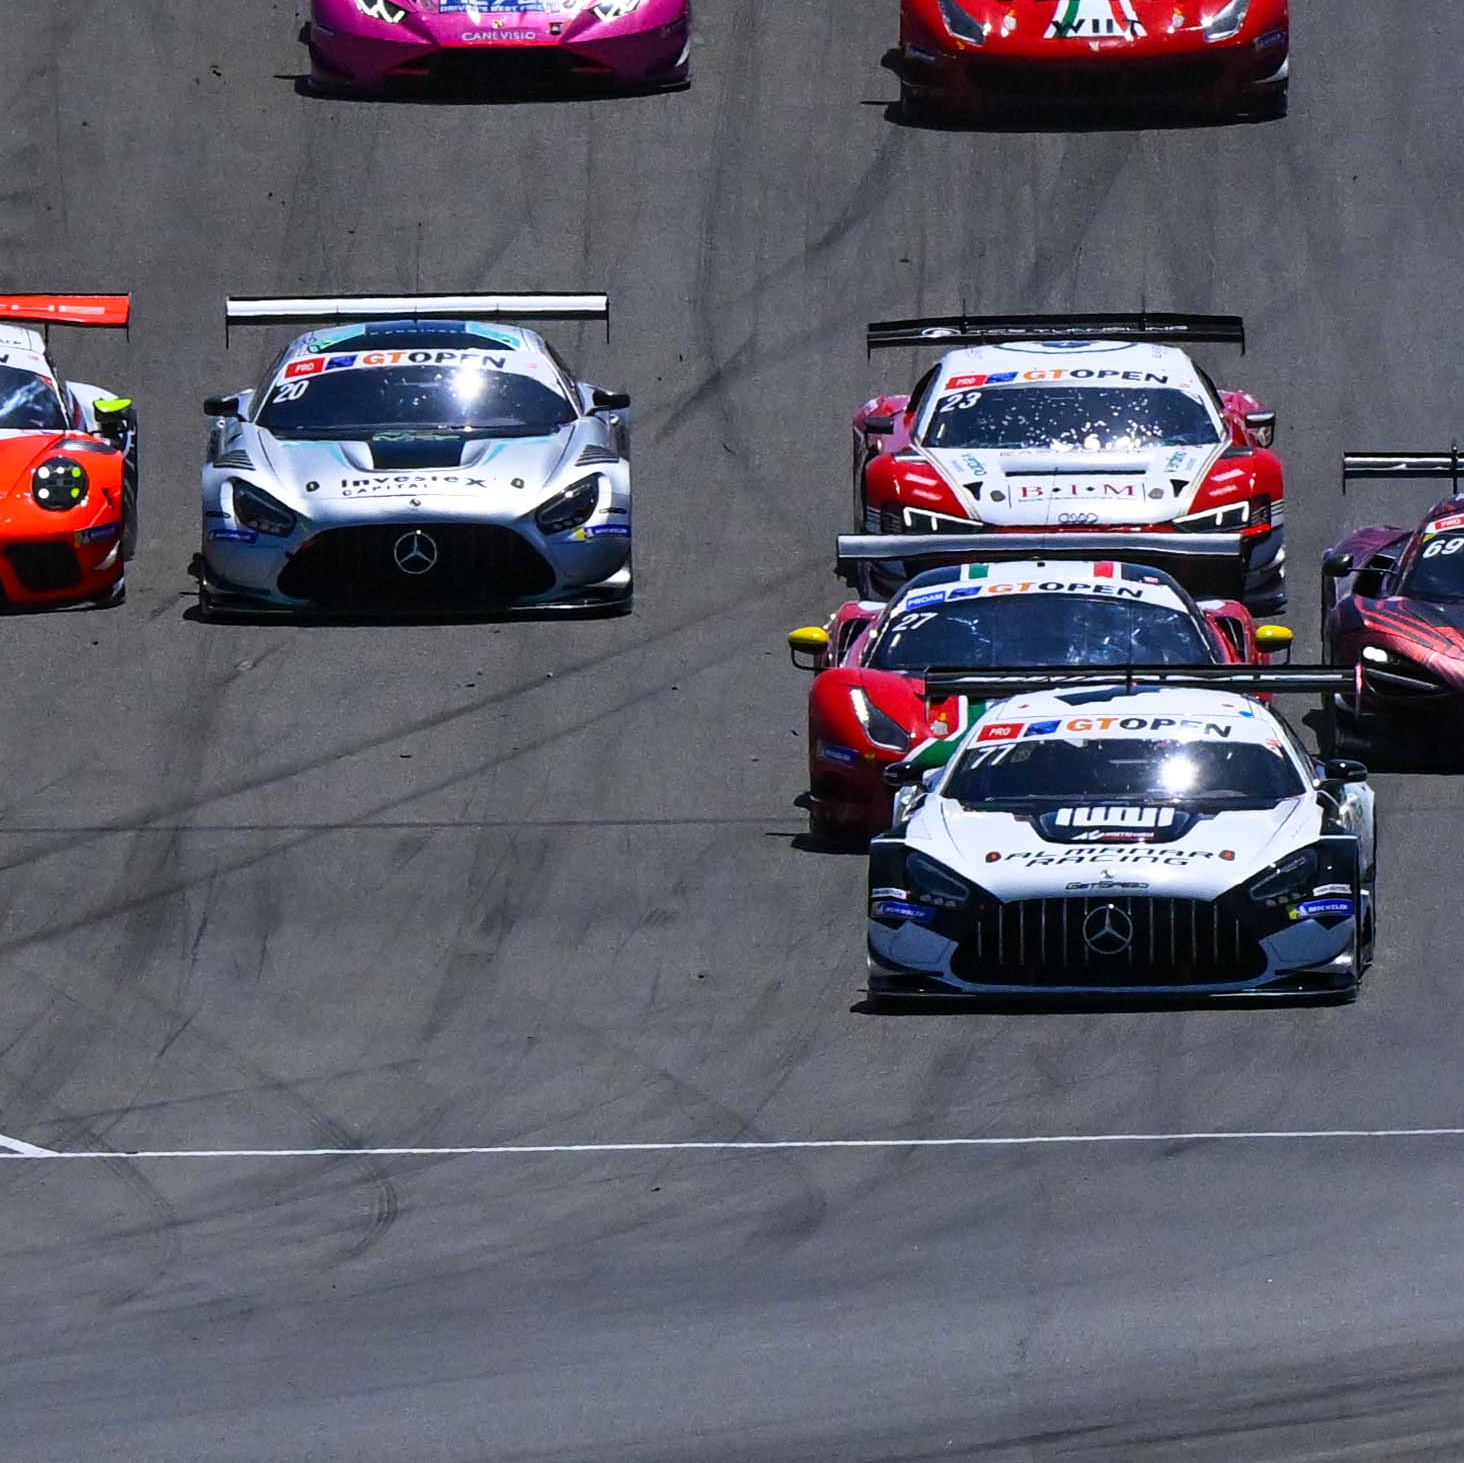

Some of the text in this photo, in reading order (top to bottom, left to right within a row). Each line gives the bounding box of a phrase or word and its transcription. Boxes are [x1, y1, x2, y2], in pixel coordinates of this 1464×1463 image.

[1022, 369, 1169, 385] GTOPEN
[272, 381, 309, 403] 20
[939, 392, 982, 413] 23
[1422, 538, 1464, 558] 69
[987, 580, 1143, 599] GTOPEN
[891, 611, 938, 632] 27
[987, 726, 1012, 738] PRO
[969, 745, 1017, 770] 77
[1026, 853, 1190, 869] RACING
